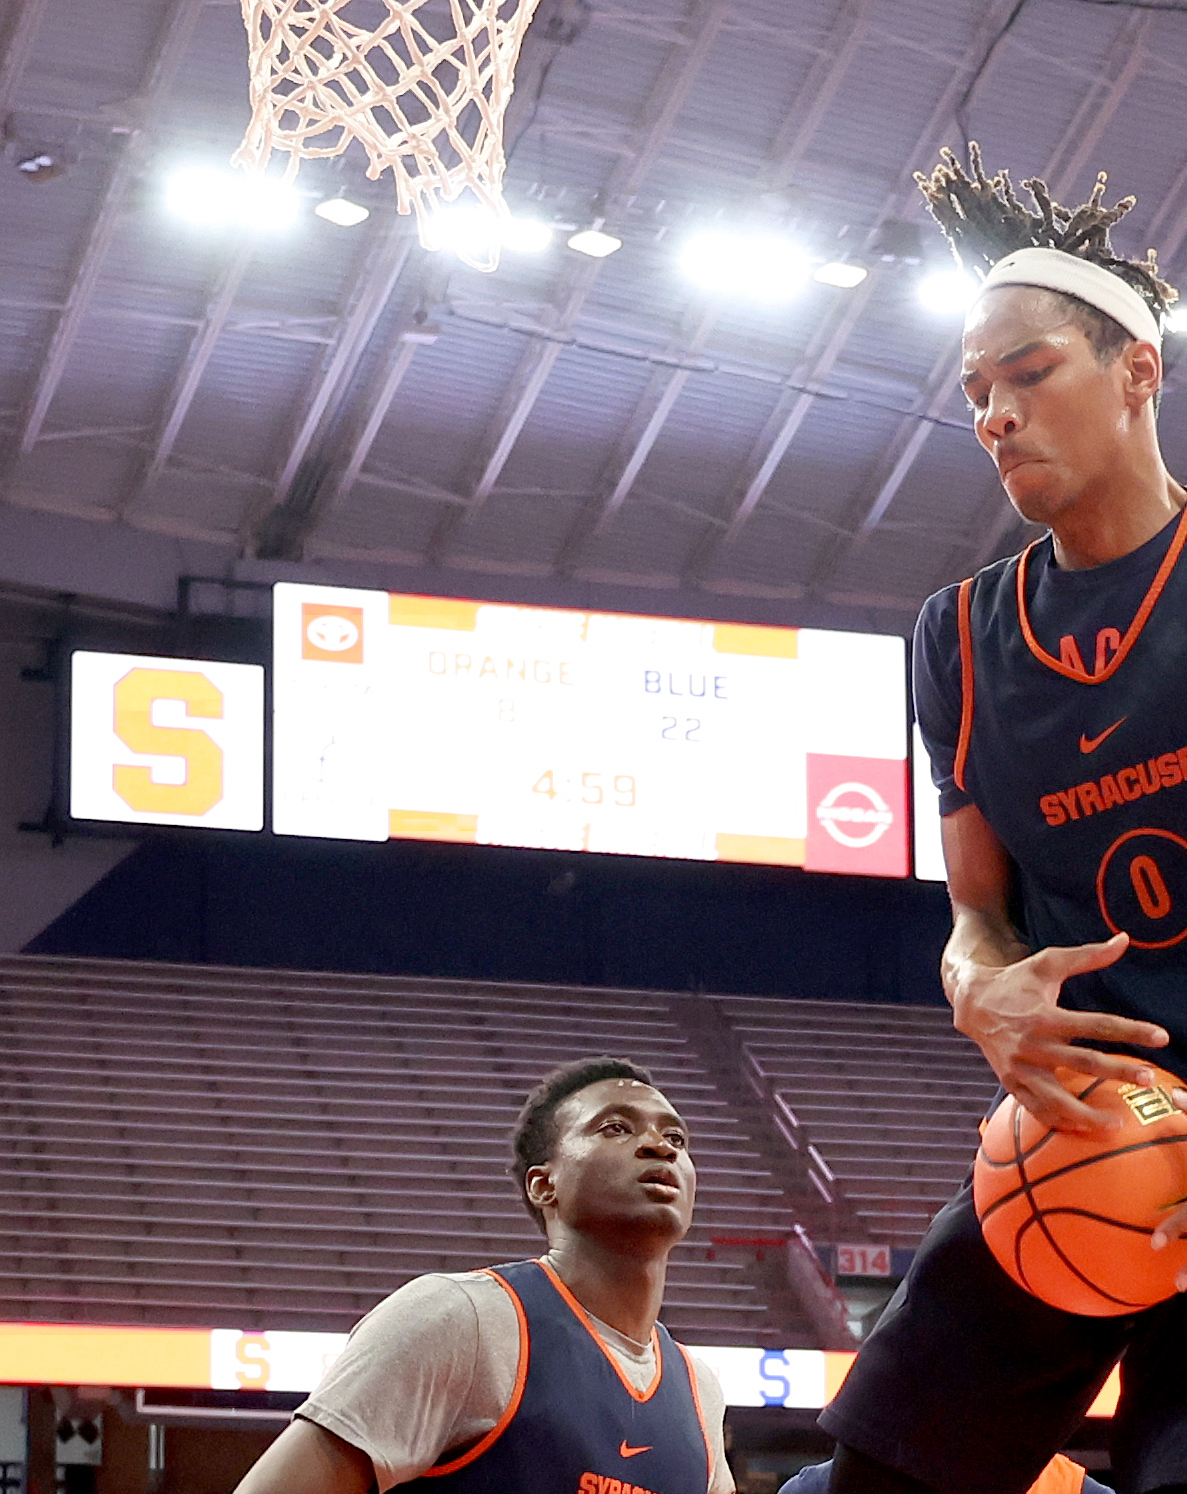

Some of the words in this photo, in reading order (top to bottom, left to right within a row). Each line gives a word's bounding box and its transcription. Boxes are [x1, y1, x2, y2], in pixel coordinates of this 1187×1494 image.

[428, 651, 574, 687] ORANGE
[644, 670, 729, 700] BLUE
[113, 666, 224, 816] S
[661, 716, 702, 742] 22
[532, 769, 637, 807] 4:59
[1129, 855, 1172, 919] 0
[838, 1248, 890, 1274] 314
